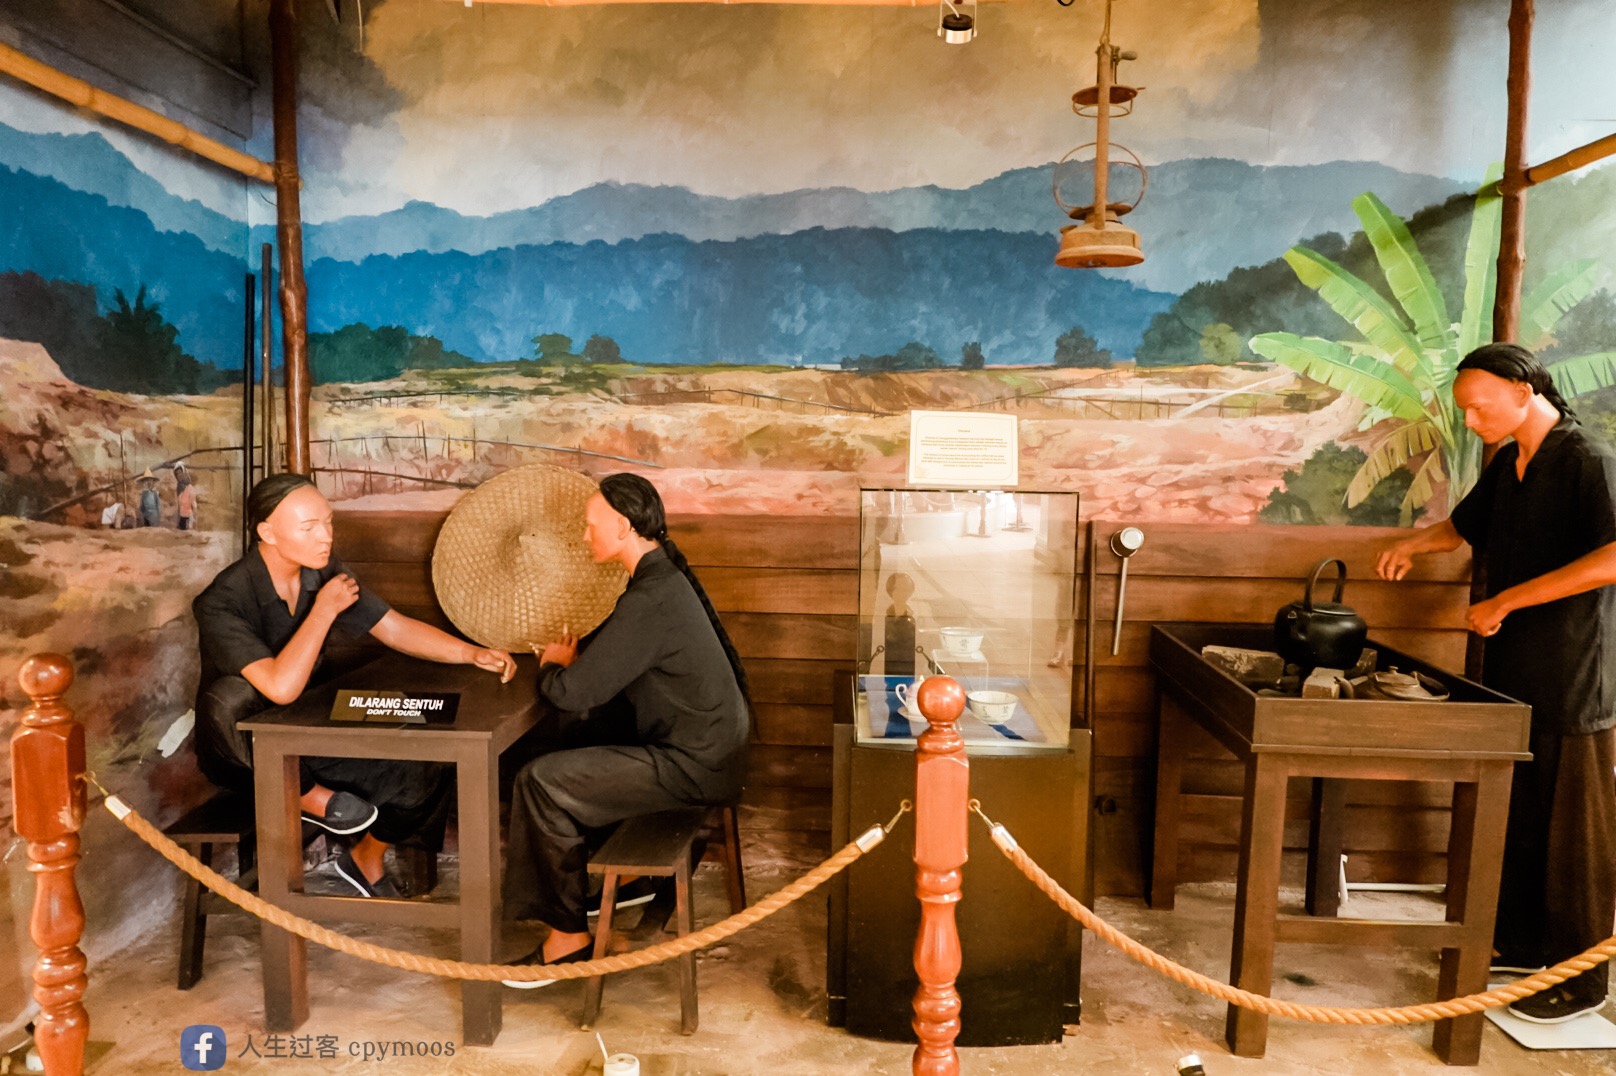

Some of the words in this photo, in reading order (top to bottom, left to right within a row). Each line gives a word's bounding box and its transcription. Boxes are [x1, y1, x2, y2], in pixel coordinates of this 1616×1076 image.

[349, 696, 401, 709] DILARANG
[402, 698, 444, 711] SENTUH
[366, 708, 391, 716] DON'T
[393, 709, 421, 717] TOUCH
